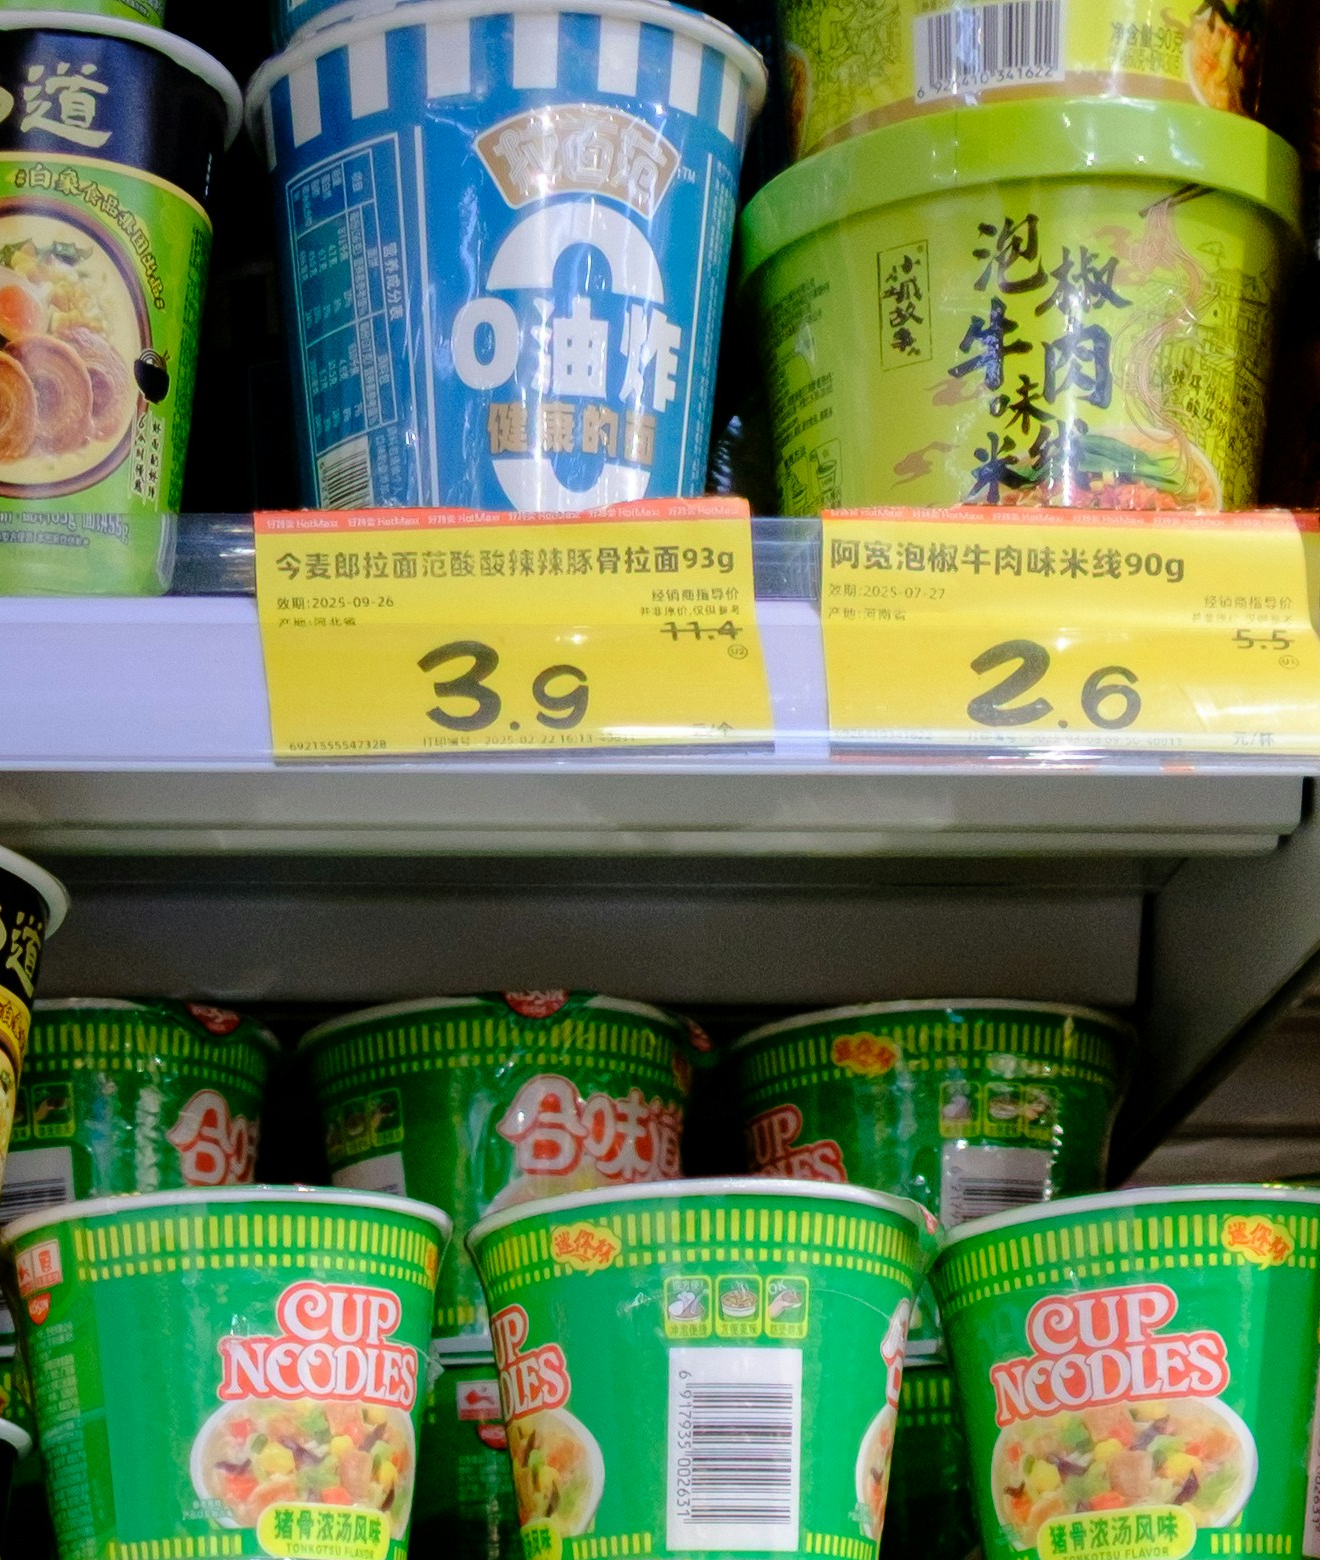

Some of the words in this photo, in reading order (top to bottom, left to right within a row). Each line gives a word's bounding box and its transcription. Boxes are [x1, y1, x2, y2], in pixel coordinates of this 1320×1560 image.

[489, 402, 657, 466] 健康的面
[275, 547, 735, 580] 今麦郎拉面范酸酸辣辣豚骨拉面93g
[830, 538, 1185, 583] 阿宽泡椒牛肉味米线90g
[276, 595, 394, 611] 效期:2025-09-26
[651, 587, 740, 602] 经销商指导价
[828, 582, 946, 601] 效期:2025-07-27
[660, 620, 743, 641] 11.4
[1232, 628, 1295, 651] 5.5
[416, 640, 589, 732] 3.9
[966, 638, 1142, 730] 2.6
[277, 1286, 401, 1343] CUP
[1027, 1286, 1178, 1356] CUP
[220, 1335, 420, 1403] NOODLES
[995, 1328, 1229, 1420] NOODLES
[271, 1511, 390, 1547] 猪骨浓汤风味
[1050, 1513, 1182, 1551] 猪骨浓汤风味
